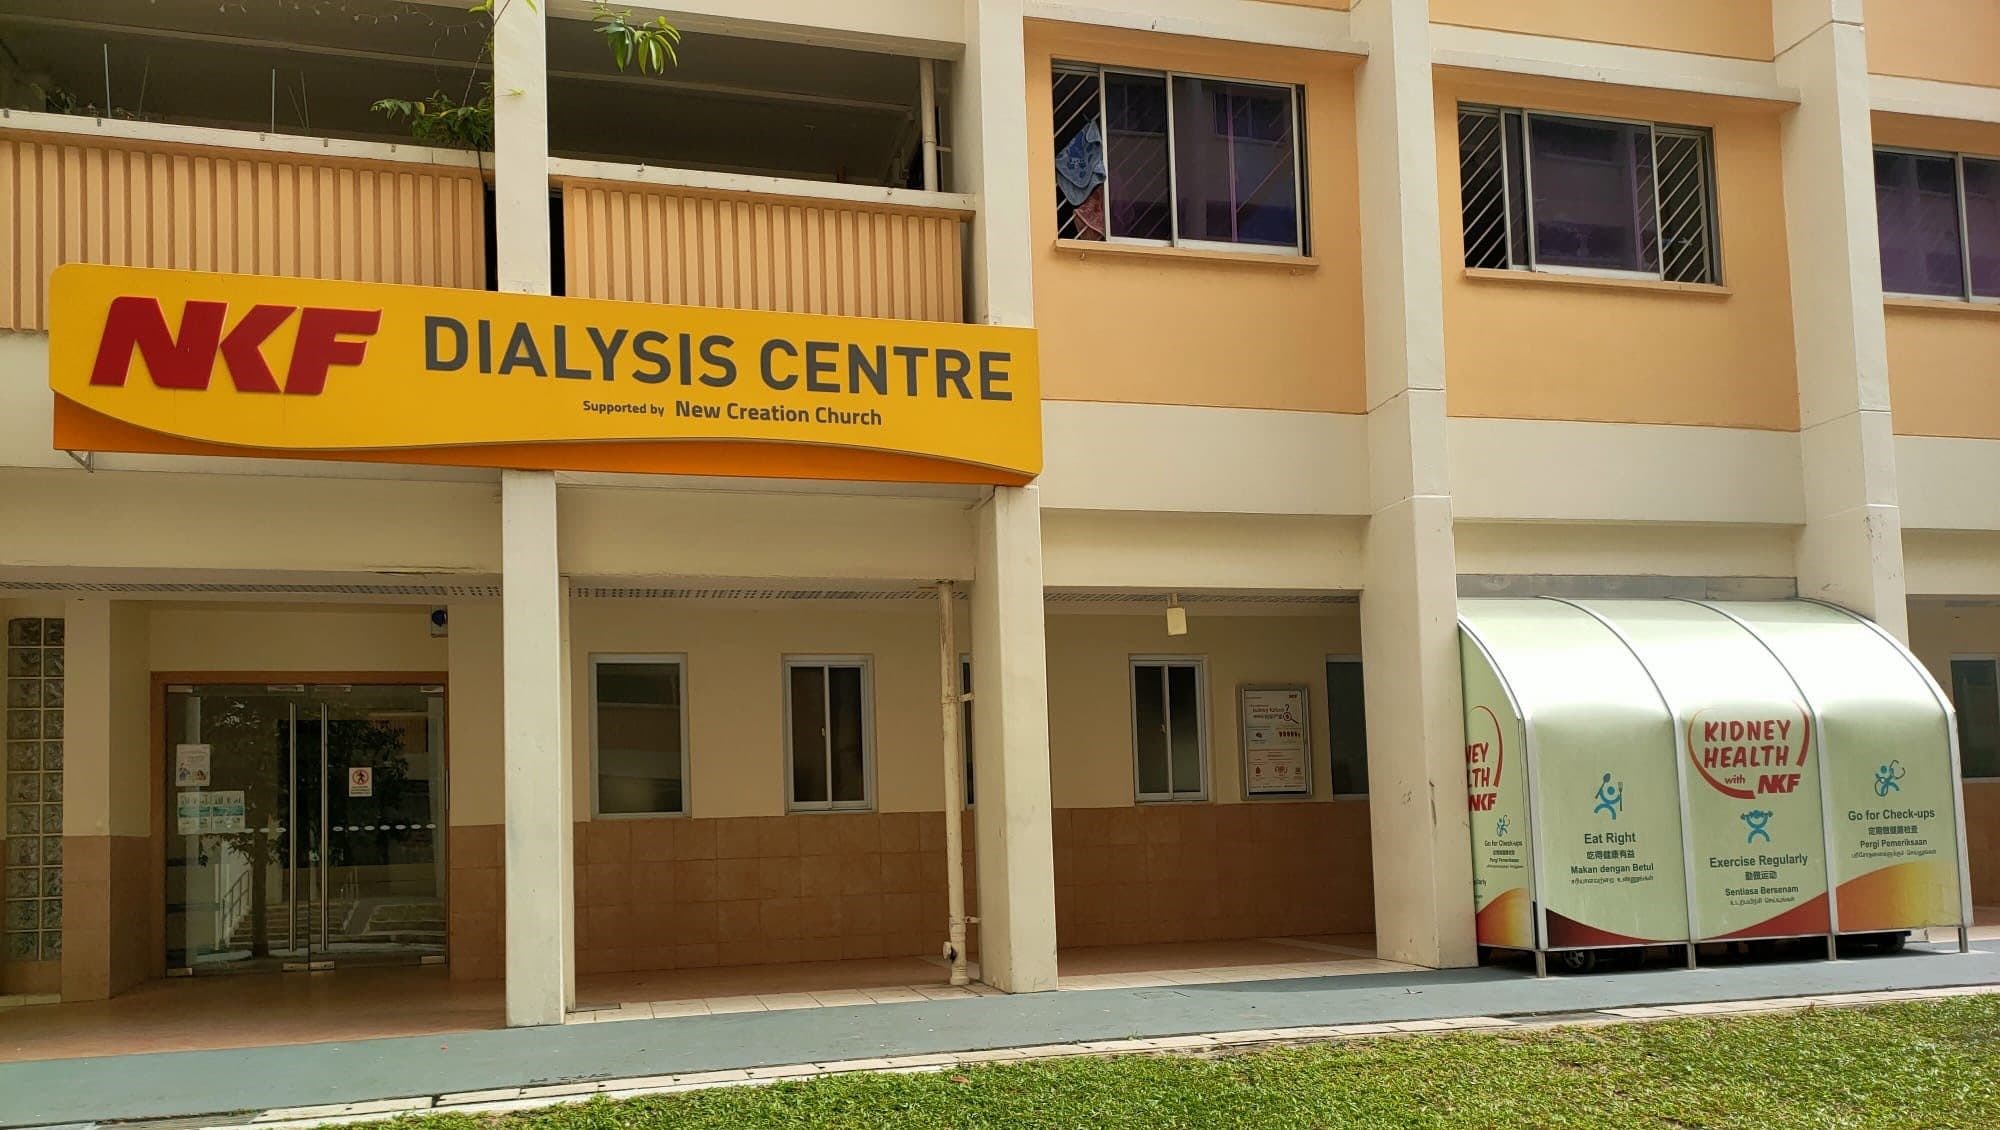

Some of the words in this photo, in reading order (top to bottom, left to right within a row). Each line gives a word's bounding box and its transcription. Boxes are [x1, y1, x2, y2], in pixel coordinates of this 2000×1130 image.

[90, 296, 383, 396] NKF
[424, 315, 737, 387] DIALYSIS
[760, 338, 1013, 402] CENTRE
[583, 400, 648, 415] Supported
[650, 403, 665, 417] by
[675, 400, 721, 419] New
[727, 402, 810, 423] Creation
[815, 406, 882, 426] Church
[1704, 719, 1791, 742] KIDNEY
[1465, 742, 1489, 763] NEY
[1704, 745, 1790, 768] HEALTH
[1467, 767, 1490, 788] LTH
[1724, 774, 1745, 785] with
[1757, 774, 1801, 794] NKF
[1469, 793, 1497, 811] NKF
[1848, 810, 1863, 821] Go
[1865, 810, 1880, 821] for
[1882, 809, 1936, 821] Check-ups
[1584, 833, 1603, 844] Eat
[1606, 832, 1636, 845] Right
[1860, 840, 1880, 849] Pergi
[1881, 838, 1928, 848] Pemeriksaan
[1571, 866, 1598, 875] Makan
[1600, 865, 1631, 874] dengan
[1632, 863, 1654, 872] Betul
[1710, 856, 1755, 868] Exercise
[1759, 853, 1808, 868] Regularly
[1725, 887, 1759, 897] Sentiasa
[1760, 886, 1799, 895] Bersenam
